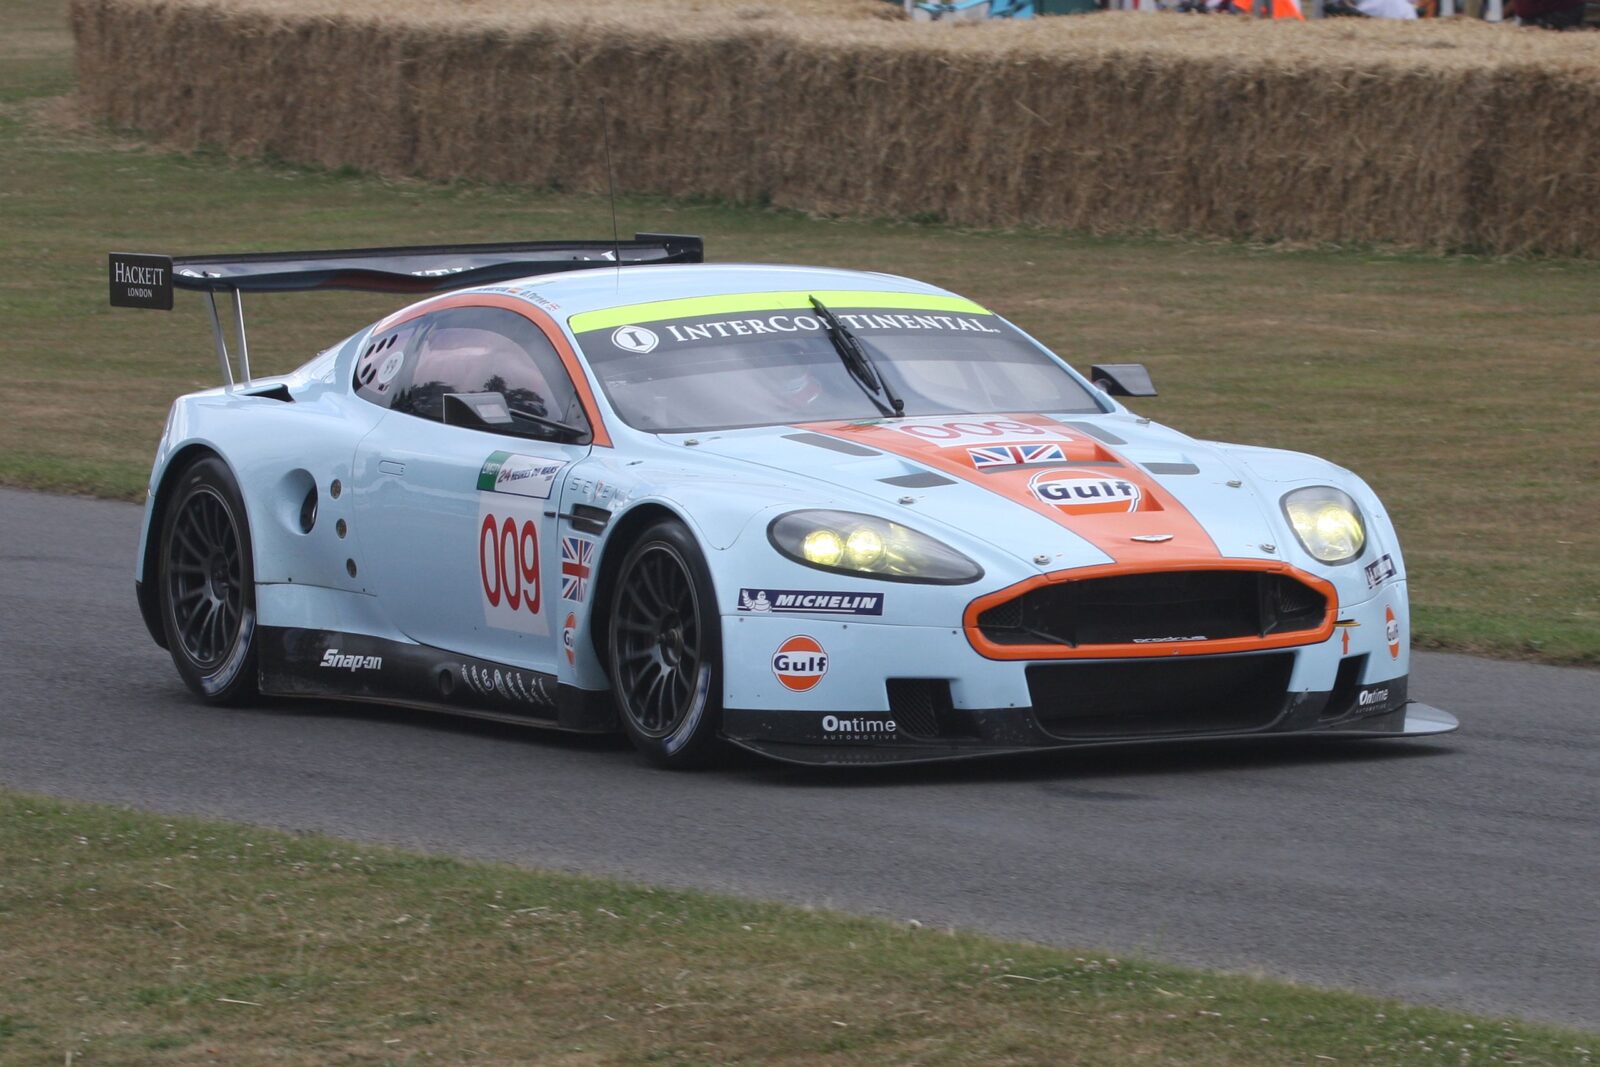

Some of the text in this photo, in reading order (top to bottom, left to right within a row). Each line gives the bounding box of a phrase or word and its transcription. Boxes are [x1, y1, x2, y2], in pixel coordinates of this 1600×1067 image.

[114, 262, 164, 286] HACKETT
[127, 287, 153, 298] LONDON
[900, 421, 1045, 439] 009
[1037, 480, 1134, 501] Gulf
[480, 512, 541, 615] 009
[774, 593, 878, 609] MICHELIN
[319, 648, 383, 673] Snap-on
[773, 654, 827, 672] Gulf
[821, 715, 897, 732] Ontime
